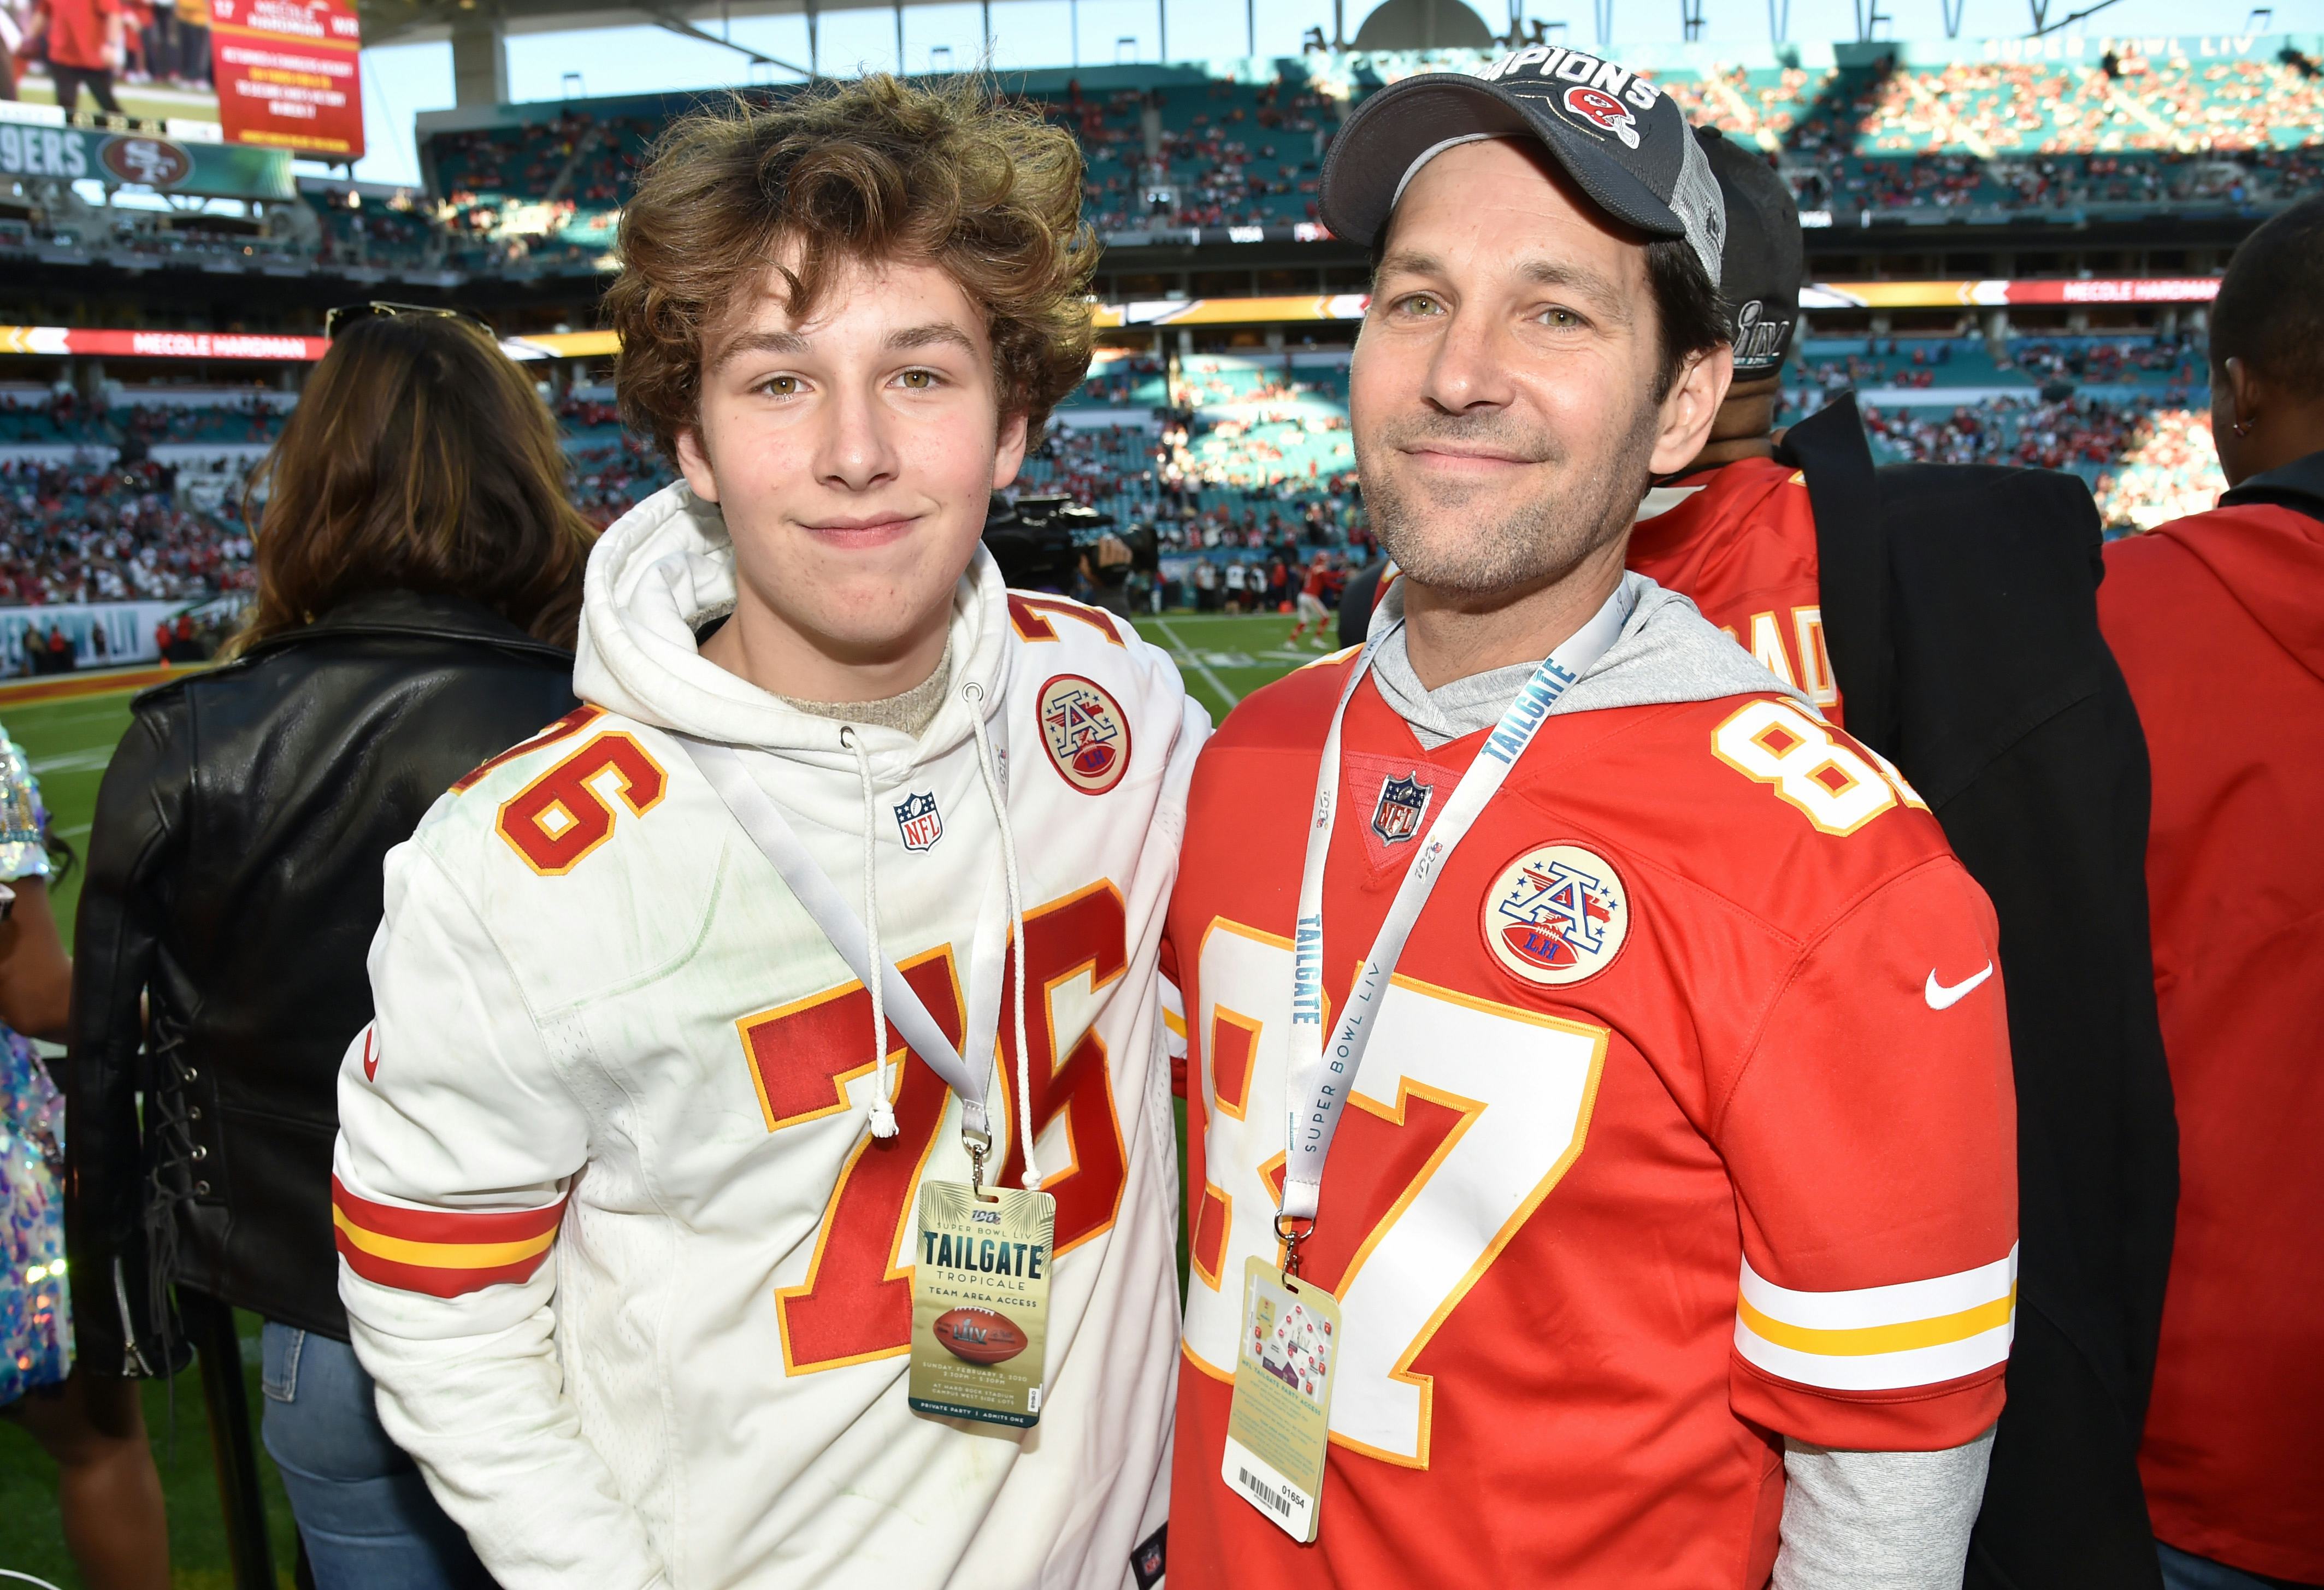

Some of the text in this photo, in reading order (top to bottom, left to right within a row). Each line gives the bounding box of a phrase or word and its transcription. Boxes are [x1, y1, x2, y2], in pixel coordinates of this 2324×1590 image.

[1983, 37, 2085, 58] SUPER
[2200, 36, 2255, 57] LIV
[133, 332, 306, 358] MECOLE HARDMAN
[1481, 658, 1577, 765] TAILGATE
[1083, 749, 1106, 769] LH
[904, 814, 940, 846] NFL
[1377, 801, 1415, 834] NFL
[1523, 932, 1560, 960] LH
[1293, 914, 1320, 1025] TAILGATE
[1305, 962, 1380, 1152] SUPER BOWL LIV
[736, 877, 1128, 1377] 76
[1180, 915, 1612, 1472] 87
[937, 1222, 971, 1232] SUPER
[978, 1227, 1007, 1237] BOWL
[924, 1231, 1044, 1280] TAILGATE
[936, 1270, 1025, 1291] TROPICALE
[929, 1286, 1037, 1308] TEAM AREA ACCESS
[957, 1367, 996, 1378] FEBRUARY
[931, 1388, 958, 1397] CAMPUS
[985, 1391, 1014, 1399] STADIUM
[921, 1402, 948, 1411] PRIVATE
[983, 1412, 1008, 1421] ADMITS
[1282, 1485, 1305, 1509] 01654
